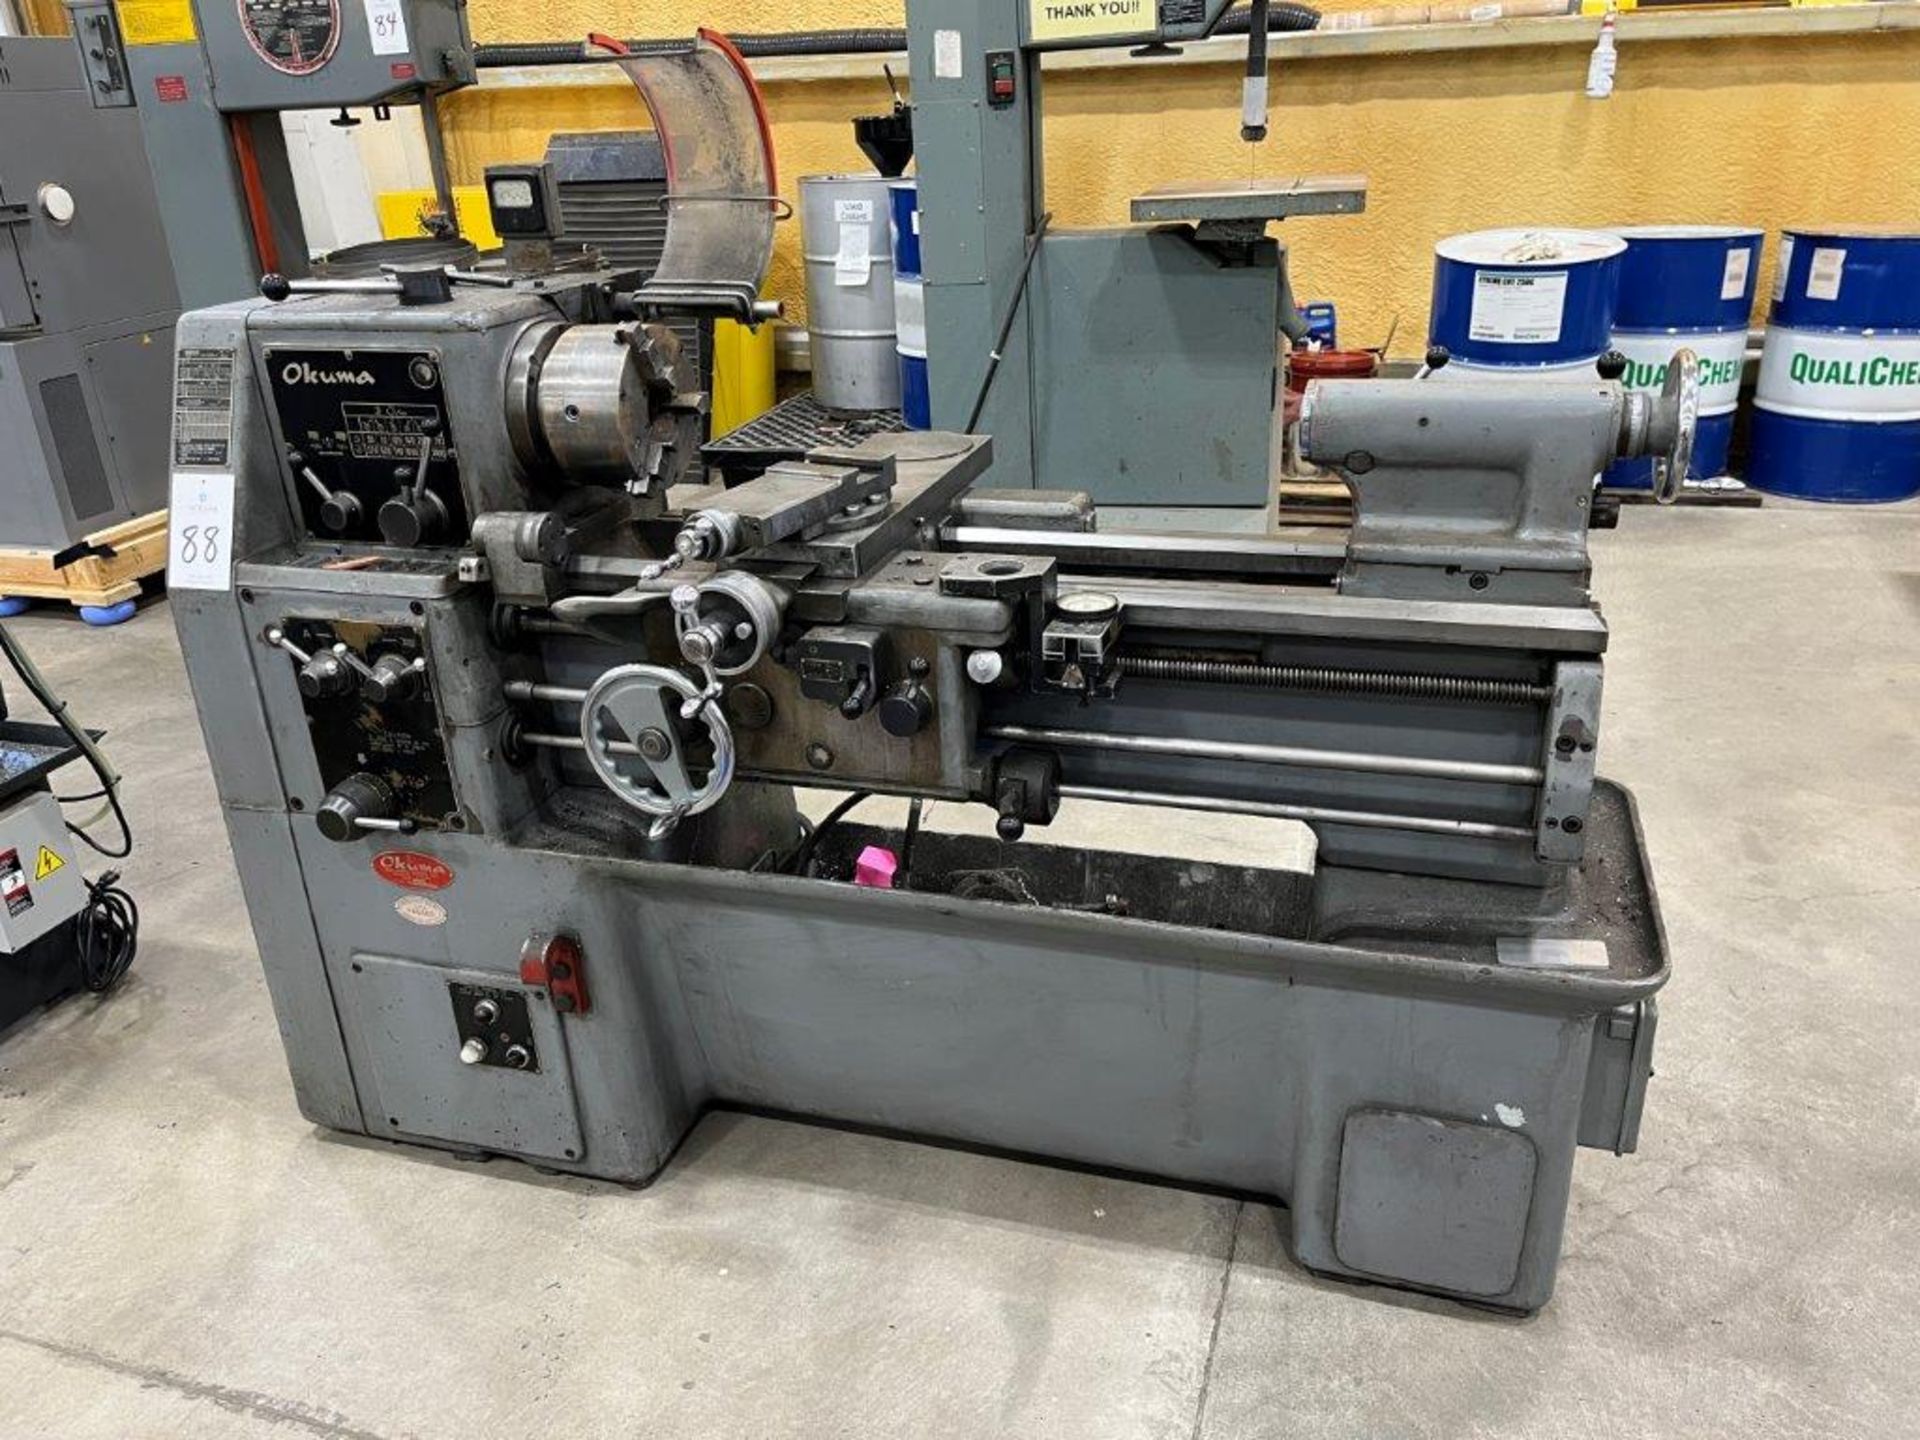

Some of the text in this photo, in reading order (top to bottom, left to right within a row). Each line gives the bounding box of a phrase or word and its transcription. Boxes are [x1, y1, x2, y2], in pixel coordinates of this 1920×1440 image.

[1045, 1, 1140, 20] THANK YOU!!
[374, 11, 398, 37] 84
[282, 362, 376, 385] Okuma
[1790, 353, 1920, 386] QUALICHE
[182, 525, 219, 563] 88
[380, 856, 446, 874] Okuma
